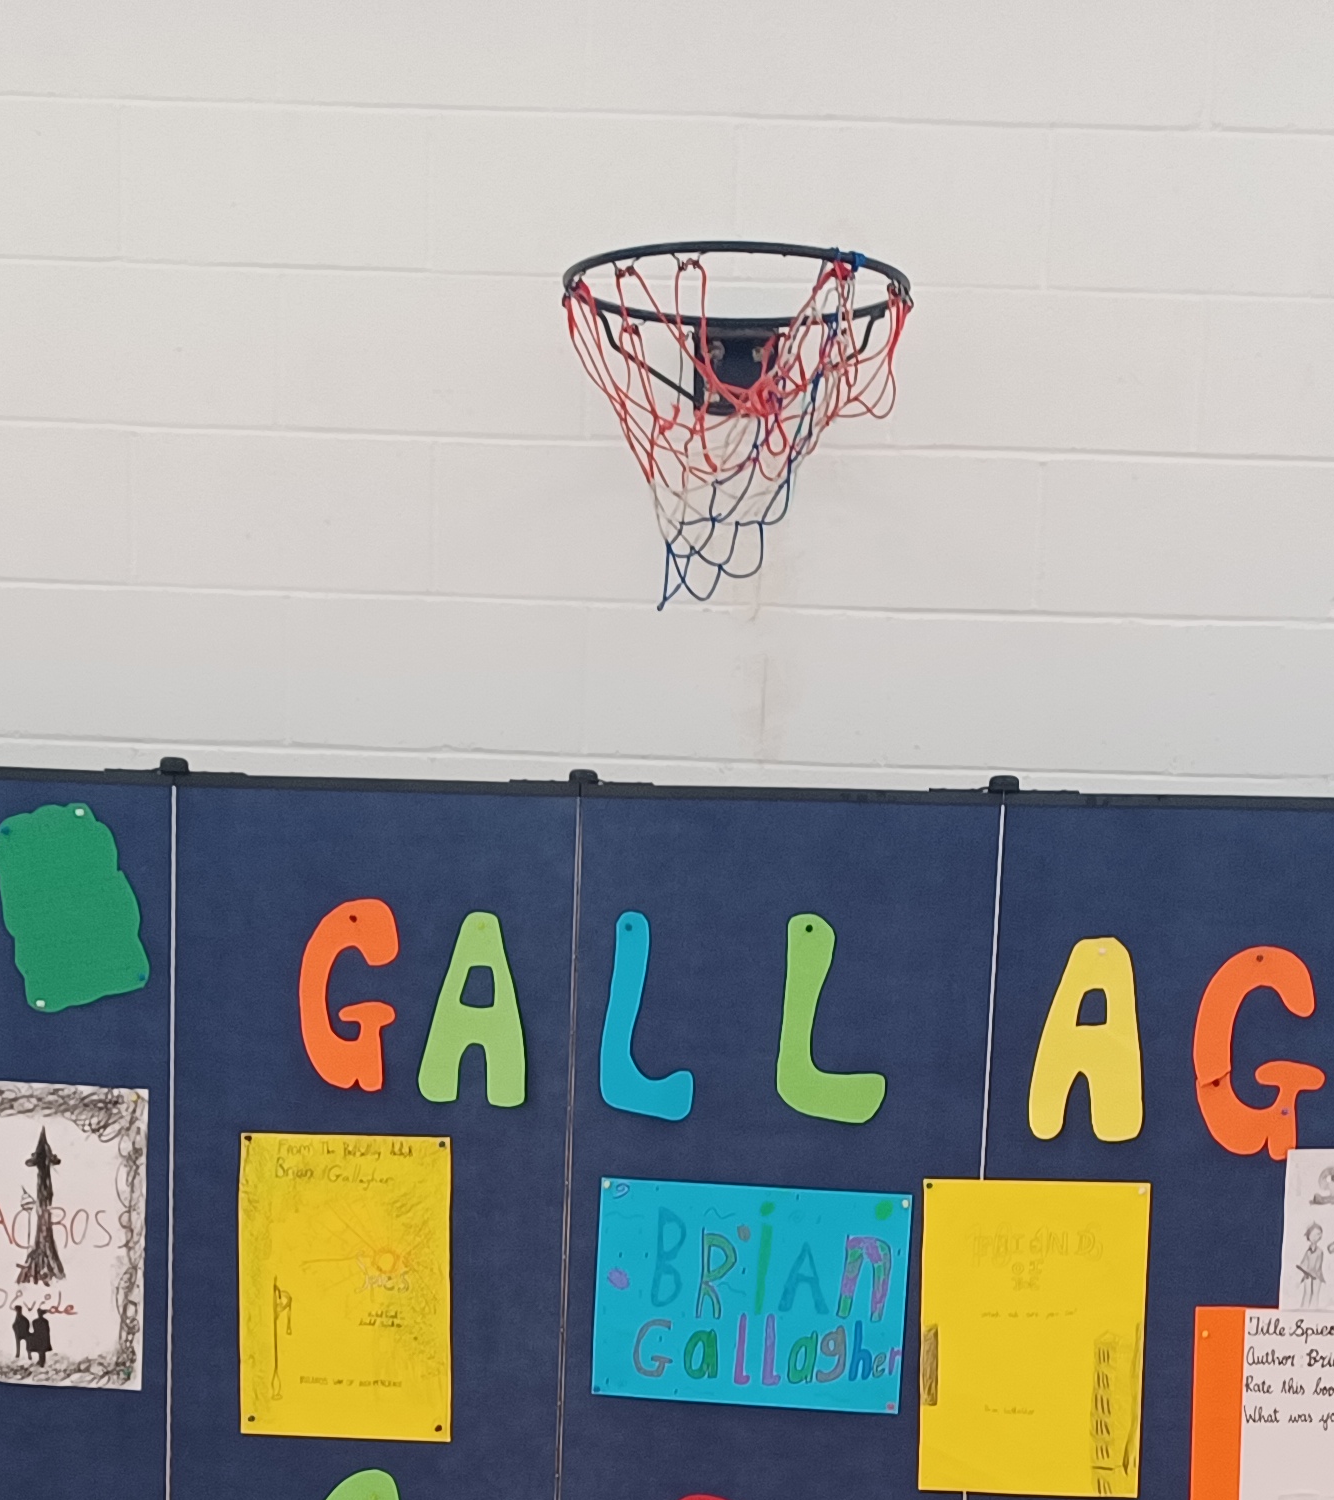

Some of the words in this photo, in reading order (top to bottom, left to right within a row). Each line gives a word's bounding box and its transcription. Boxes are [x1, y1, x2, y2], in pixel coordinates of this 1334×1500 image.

[633, 1313, 902, 1385] Gallagher
[1245, 1375, 1274, 1394] Rate
[1281, 1378, 1306, 1395] this
[1243, 1404, 1280, 1424] What
[1288, 1412, 1313, 1424] was
